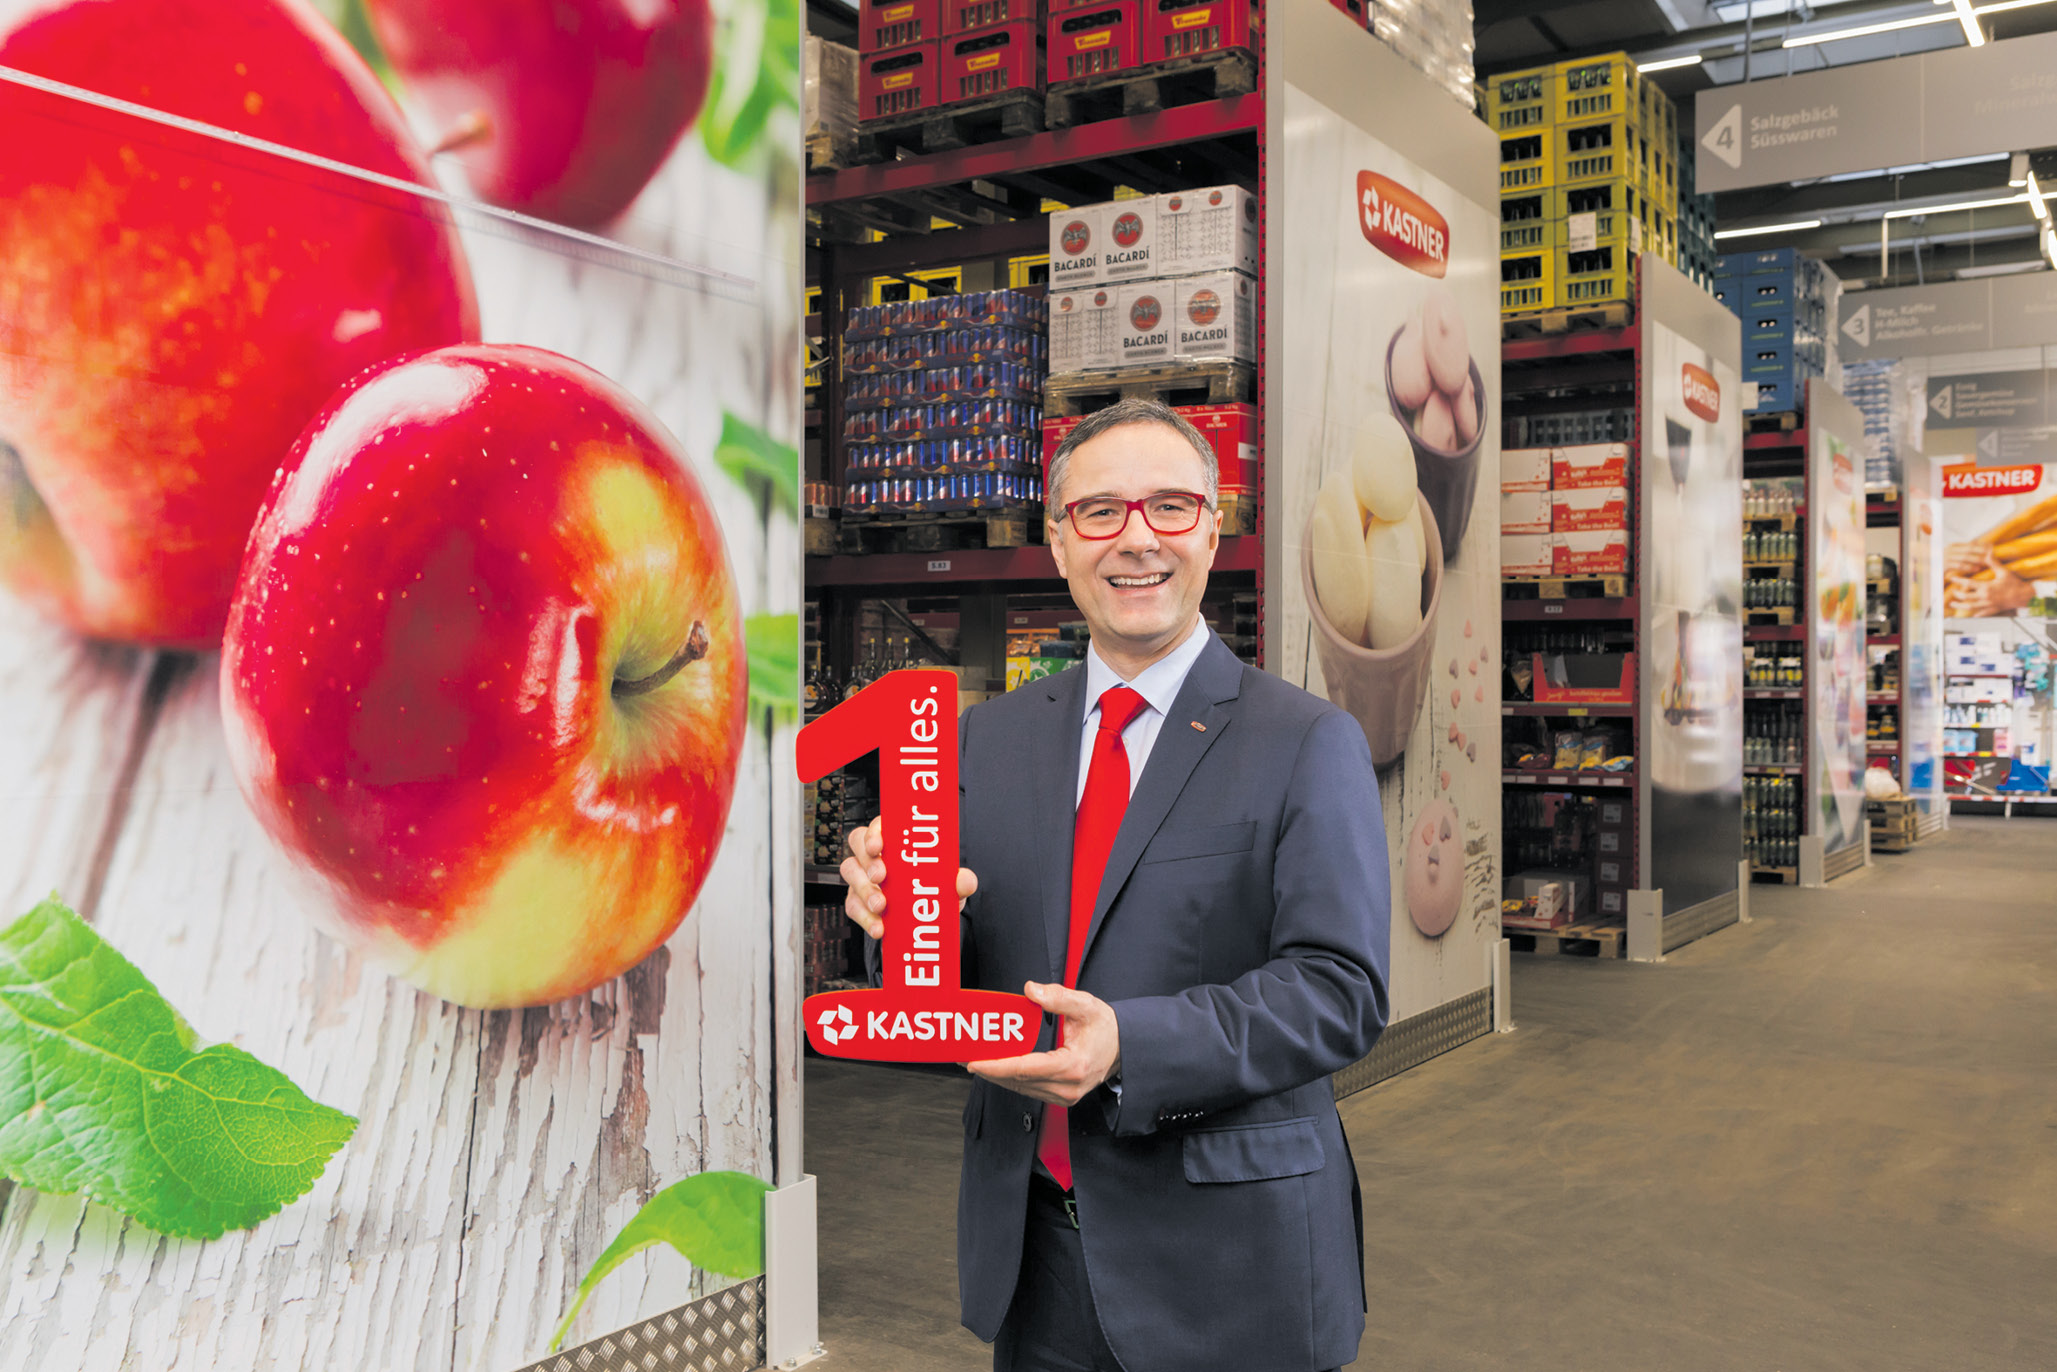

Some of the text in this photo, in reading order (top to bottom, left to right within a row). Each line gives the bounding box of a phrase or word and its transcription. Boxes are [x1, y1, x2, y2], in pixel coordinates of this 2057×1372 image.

[1750, 104, 1839, 131] Salzgebäck
[1716, 125, 1735, 150] 4
[1750, 124, 1838, 149] Süsswaren
[1383, 200, 1444, 262] KASTNER
[1054, 253, 1097, 272] BACARDÍ
[1105, 246, 1150, 265] BACARDÍ
[1180, 324, 1228, 343] BACARDÍ
[1853, 319, 1864, 335] 3
[1123, 330, 1168, 348] BACARDÍ
[1938, 395, 1948, 409] 2
[1948, 469, 2035, 490] KASTNER
[900, 685, 940, 986] Einer für alles.
[867, 1011, 1024, 1042] KASTNER
